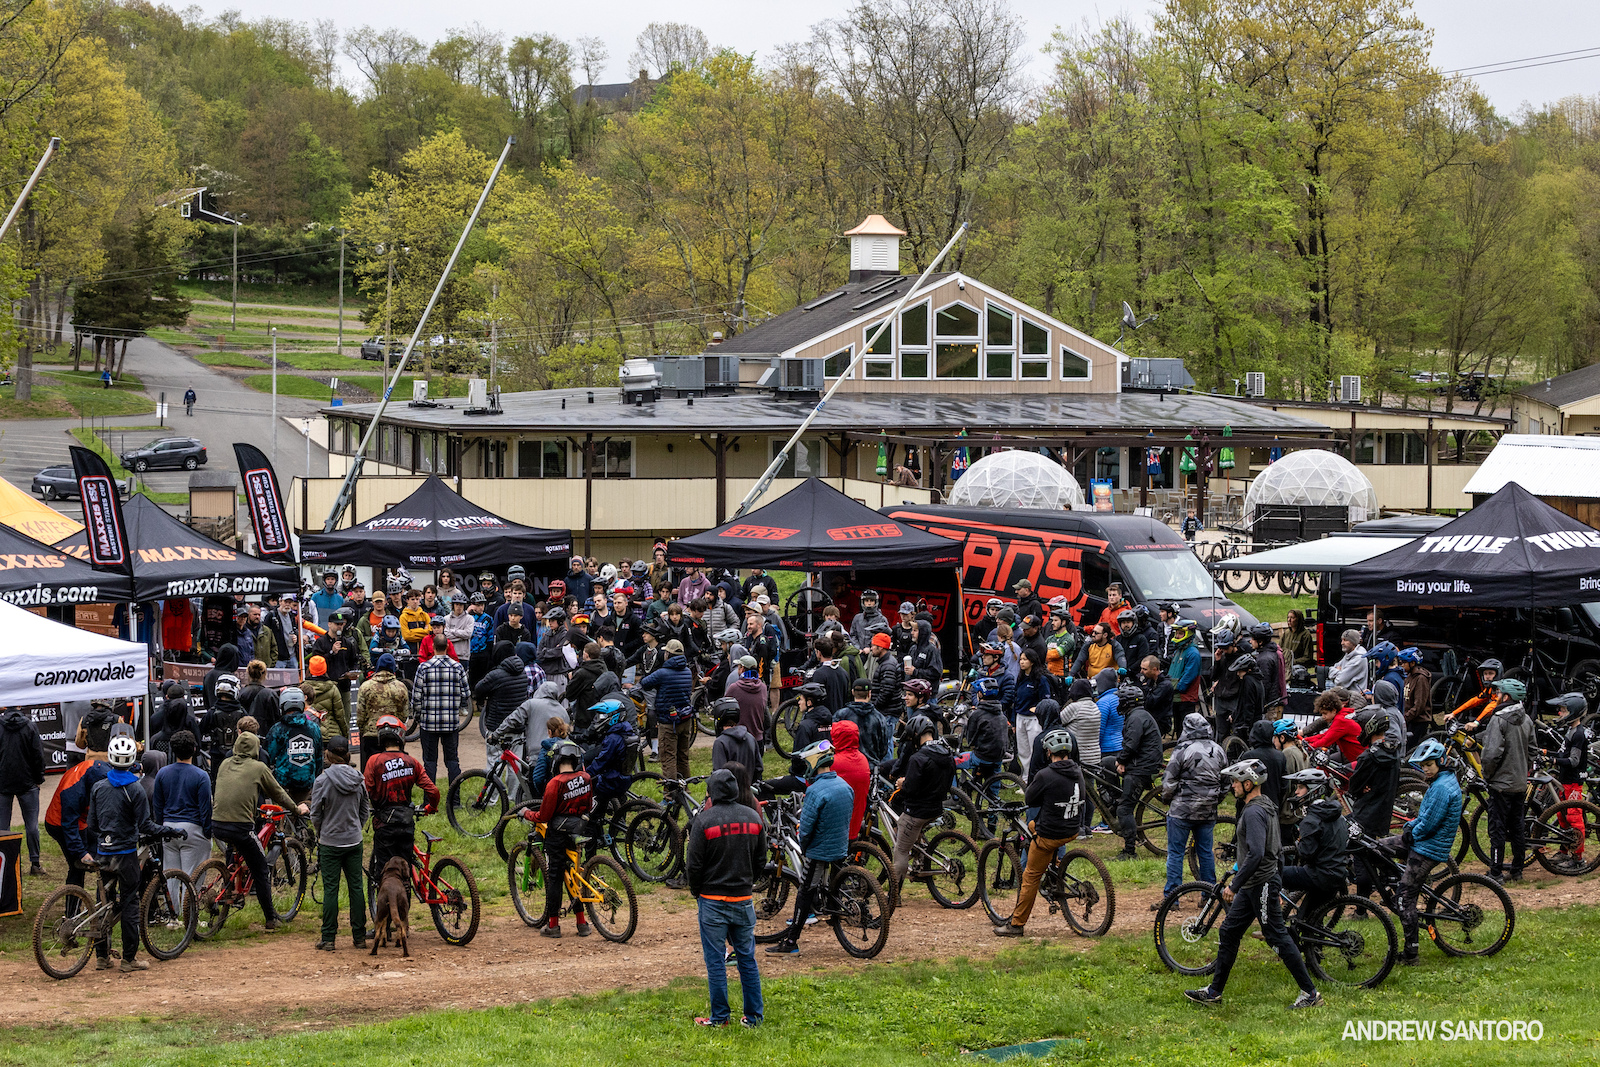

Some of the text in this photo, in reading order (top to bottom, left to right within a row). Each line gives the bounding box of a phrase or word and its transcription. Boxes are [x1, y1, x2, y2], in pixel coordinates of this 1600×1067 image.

[252, 475, 277, 546] MAXXIS ESC
[262, 475, 283, 544] EASTERN STATES CUP
[87, 482, 112, 557] MAXXIS ESC
[99, 482, 118, 555] EASTERN STATES CUP
[365, 517, 432, 530] ROTATION
[437, 515, 503, 530] ROTATION
[21, 520, 76, 535] KATE'S
[724, 525, 793, 540] STANS
[830, 526, 900, 539] STANS
[545, 544, 570, 554] ROTATION
[1417, 535, 1513, 554] THULE
[138, 546, 236, 563] MAXXIS
[409, 555, 436, 563] ROTATION
[440, 554, 466, 564] ROTATION
[166, 573, 269, 597] maxxis.com
[1396, 579, 1473, 594] Bring your life.
[0, 583, 98, 606] axxis.com
[34, 661, 135, 687] cannondale
[40, 708, 57, 716] KATE'S
[39, 731, 66, 740] ondale
[291, 742, 311, 750] P27
[385, 758, 405, 771] 054
[381, 767, 414, 782] SYNDICATE
[567, 776, 585, 790] 054
